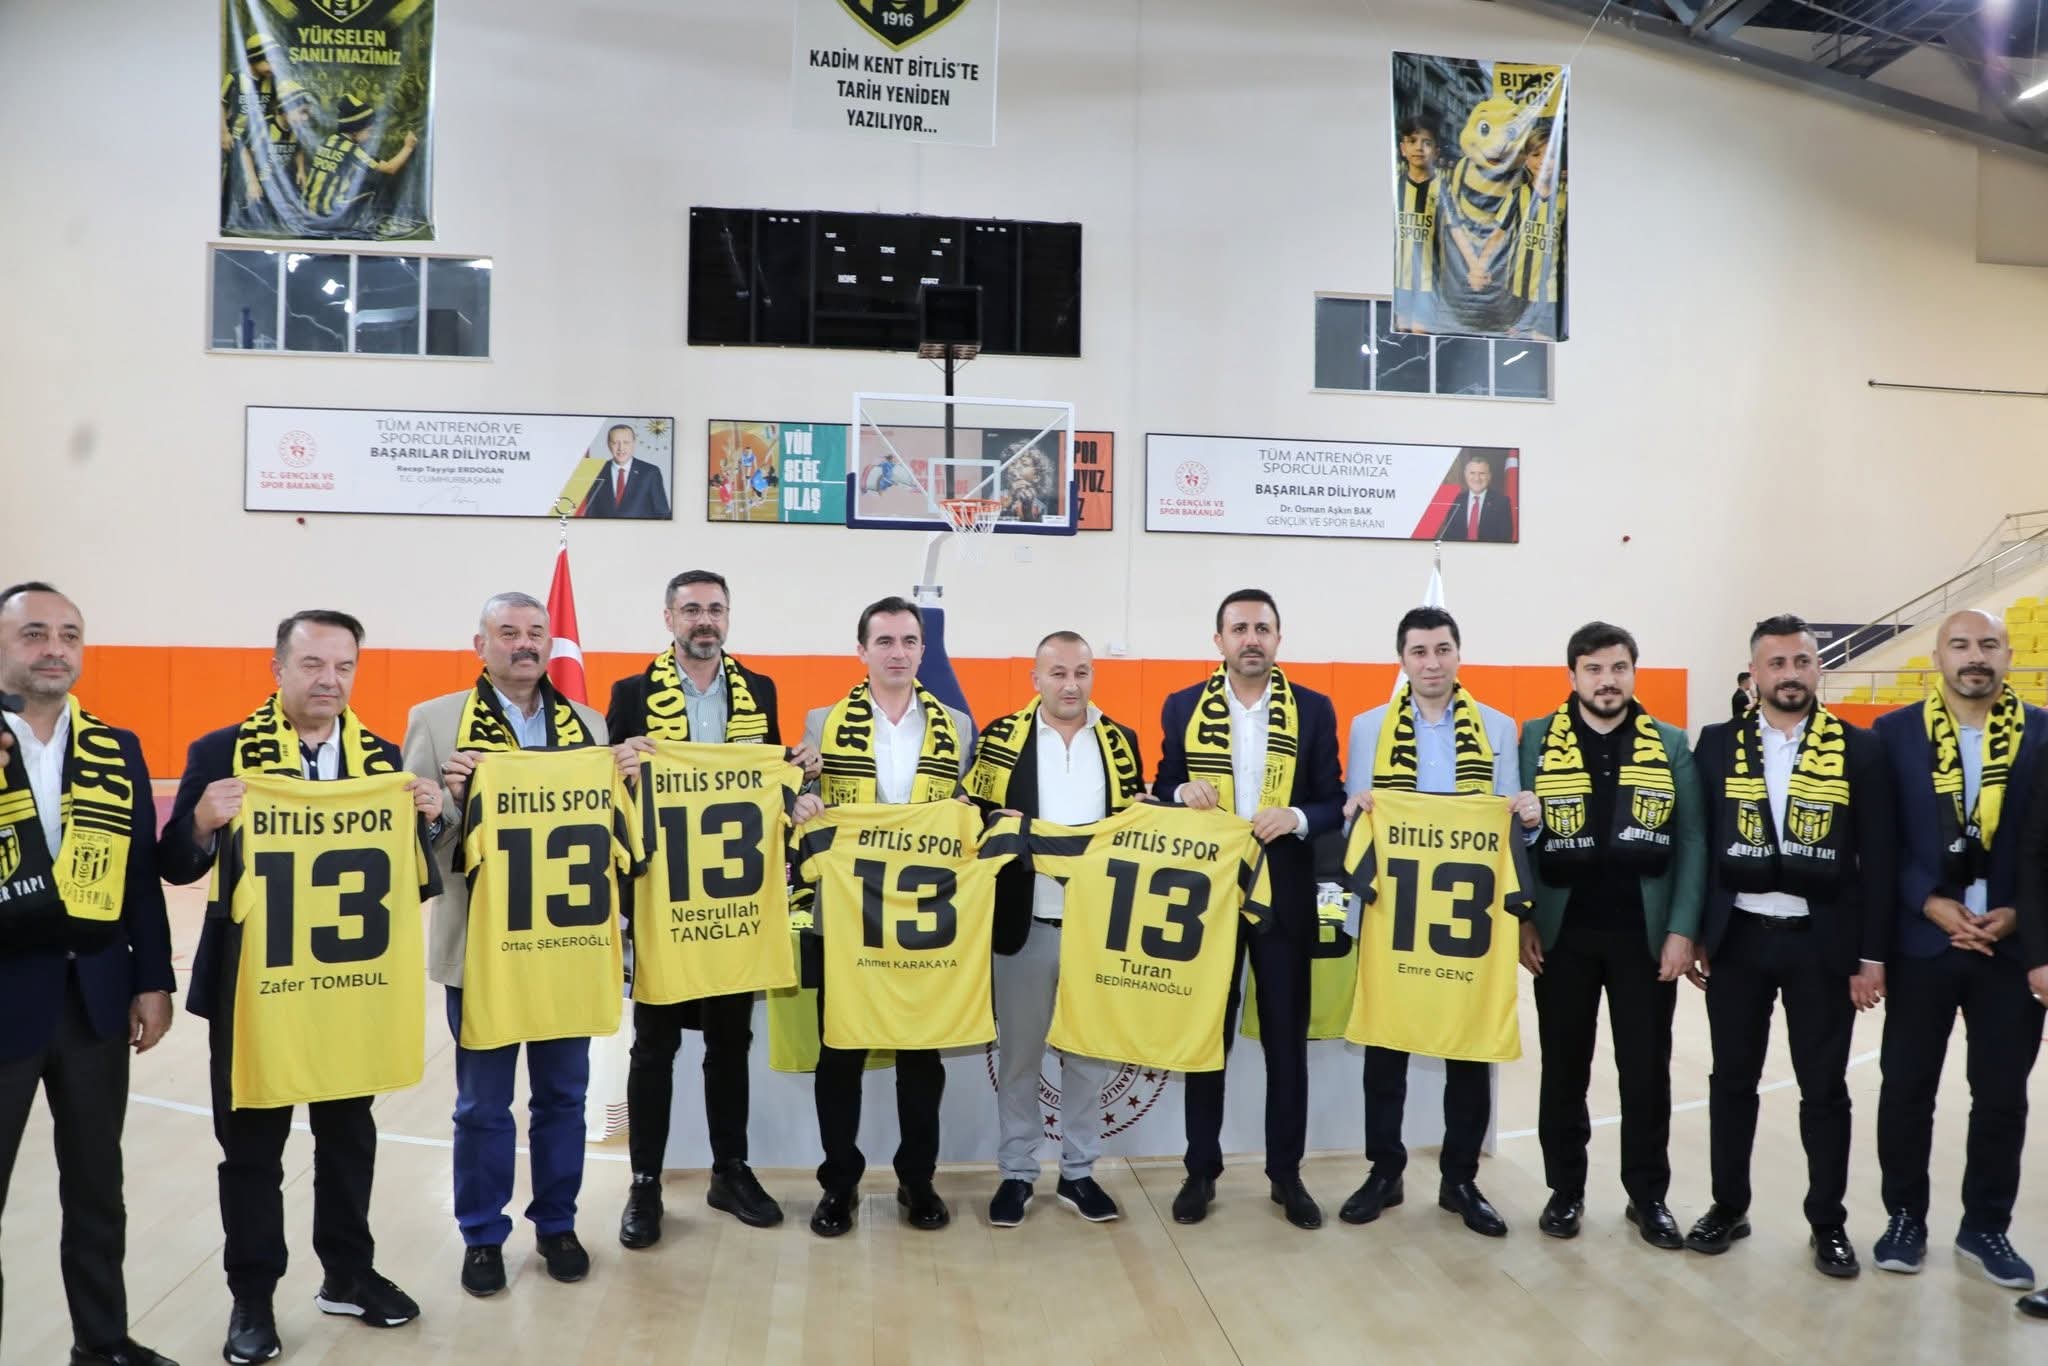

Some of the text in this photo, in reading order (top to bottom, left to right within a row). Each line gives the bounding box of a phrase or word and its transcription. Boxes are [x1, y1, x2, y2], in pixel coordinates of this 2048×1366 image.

[882, 11, 914, 27] 1916
[297, 25, 387, 46] YÜKSELEN
[288, 47, 401, 66] ŞANLI MAZİMİZ
[809, 48, 979, 81] KADİM KENT BİTLİS'TE
[837, 79, 950, 106] TARİH YENİDEN
[847, 109, 937, 133] YAZILIYOR...
[376, 418, 522, 434] TÜM ANTRENÖR VE
[379, 432, 517, 446] SPORCULARIMIZA
[370, 448, 531, 461] BAŞARILAR DİLİYORUM
[1259, 448, 1392, 465] TÜM ANTRENÖR VE
[1263, 462, 1388, 477] SPORCULARIMIZA
[1255, 484, 1396, 499] BAŞARILAR DİLİYORUM
[1280, 504, 1293, 512] Dr.
[1295, 505, 1326, 513] Osman
[1354, 507, 1372, 515] BAK
[1310, 517, 1321, 526] VE
[1323, 518, 1348, 527] SPOR
[656, 767, 763, 793] BİTLİS SPOR
[497, 786, 612, 815] BİTLİS SPOR
[253, 805, 393, 835] BİTLİS SPOR
[858, 826, 962, 858] BİTLİS SPOR
[1112, 827, 1220, 862] BİTLİS SPOR
[1389, 822, 1500, 852] BİTLİS SPOR
[658, 801, 764, 903] 13
[497, 824, 612, 932] 13
[254, 847, 391, 968] 13
[671, 901, 760, 923] Nesrullah
[853, 858, 957, 950] 13
[1106, 858, 1211, 962] 13
[1387, 857, 1496, 958] 13
[670, 919, 762, 943] TANĞLAY
[501, 941, 533, 952] Ortaç
[856, 957, 958, 970] Ahmet KARAKAYA
[1120, 958, 1172, 980] Turan
[1398, 963, 1474, 983] Emre GENÇ
[259, 972, 389, 995] Zafer TOMBUL
[1095, 973, 1193, 997] BEDİRHANOĞLU
